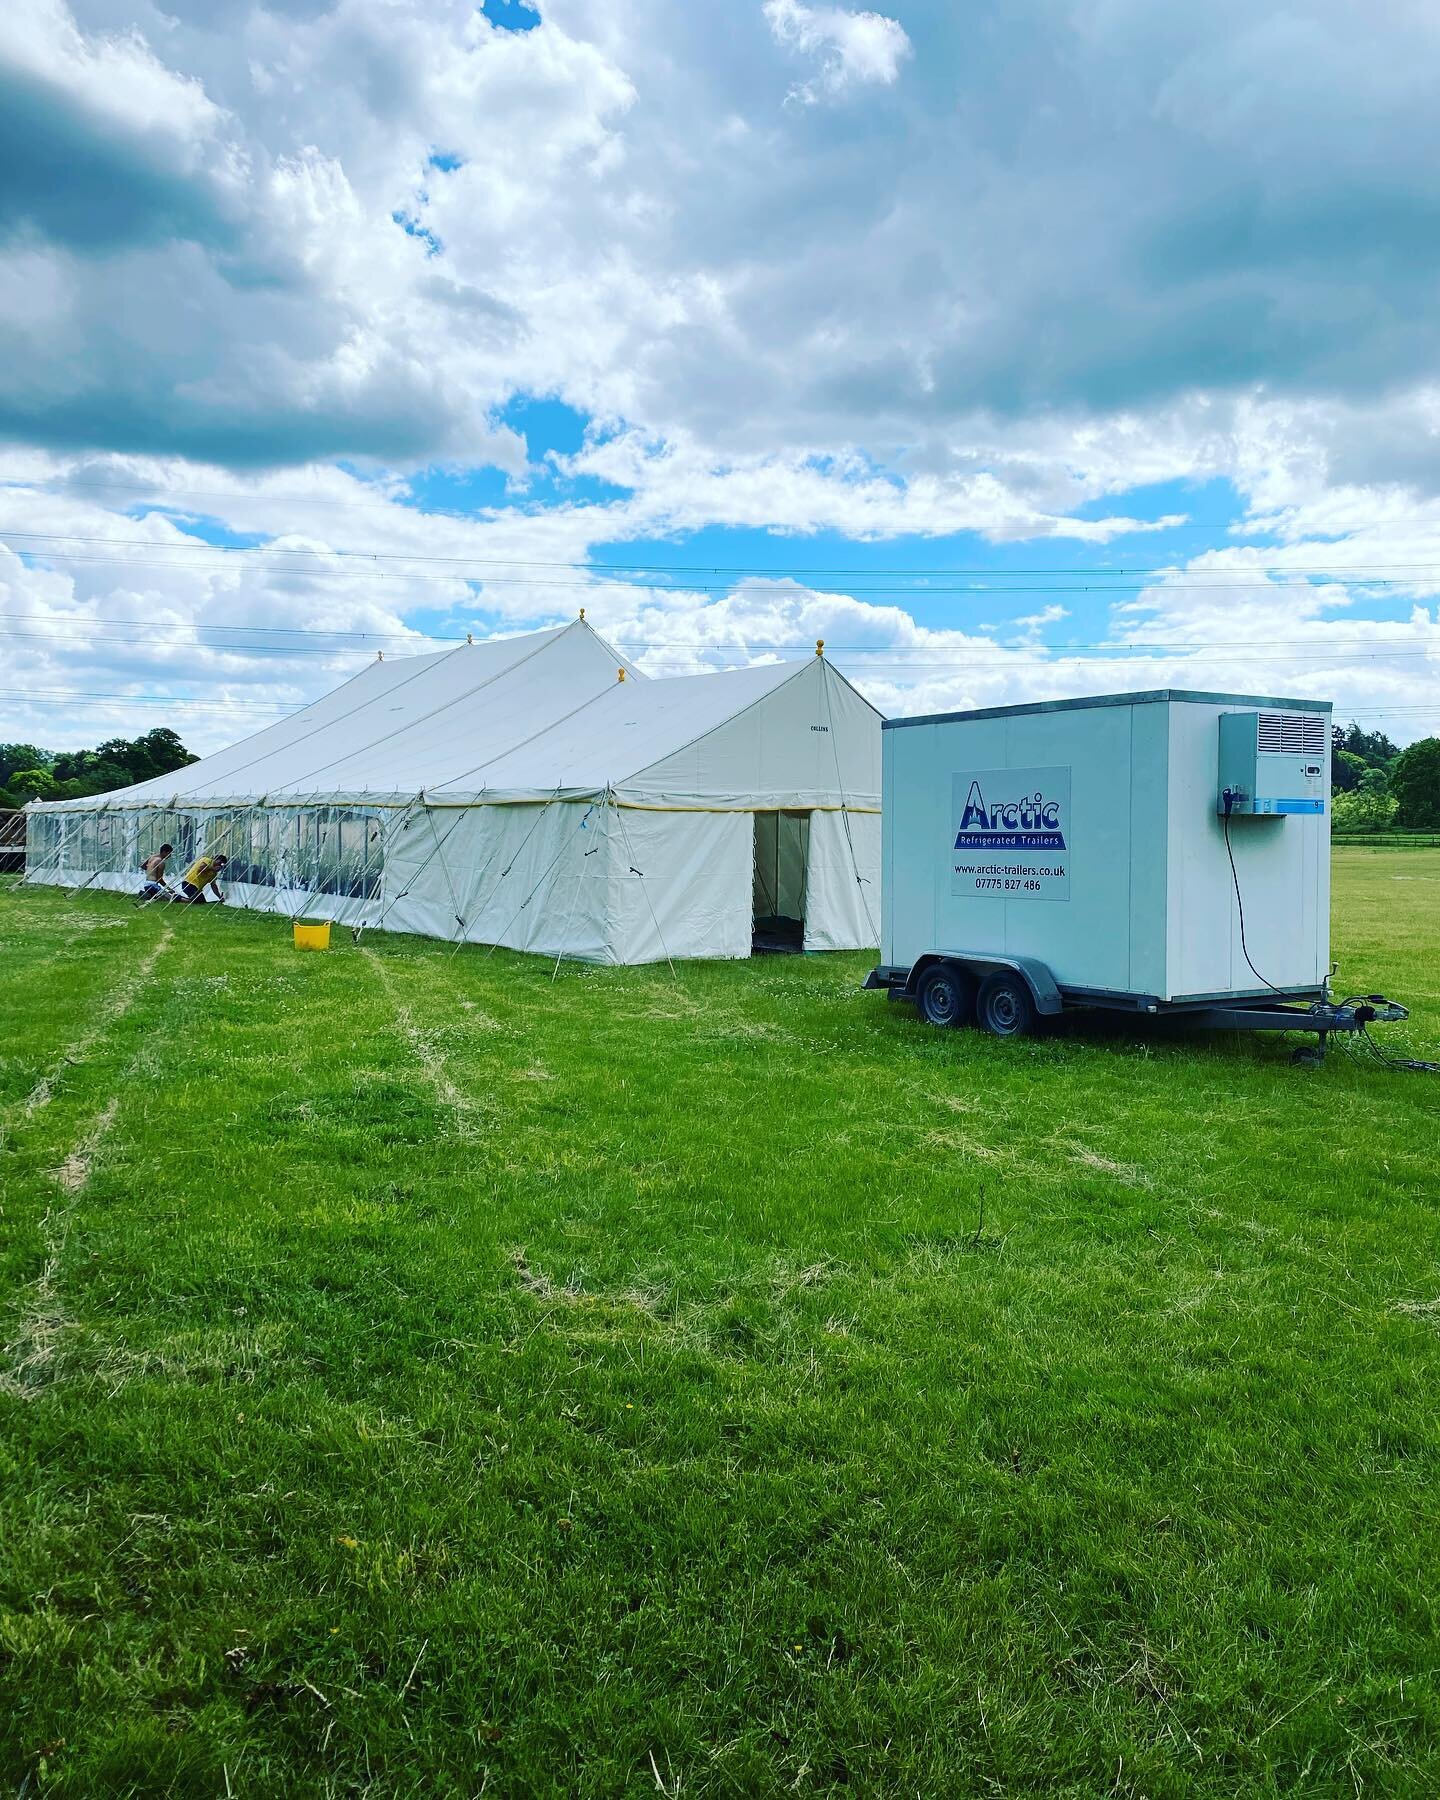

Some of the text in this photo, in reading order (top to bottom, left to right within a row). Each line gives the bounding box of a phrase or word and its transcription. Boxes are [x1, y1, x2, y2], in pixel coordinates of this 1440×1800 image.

[960, 780, 1060, 829] Arctic
[961, 836, 1059, 846] Refrigerated Trailers
[954, 864, 1066, 877] www.arctic-trailers.co.uk
[975, 878, 1041, 891] 07775 827 486
